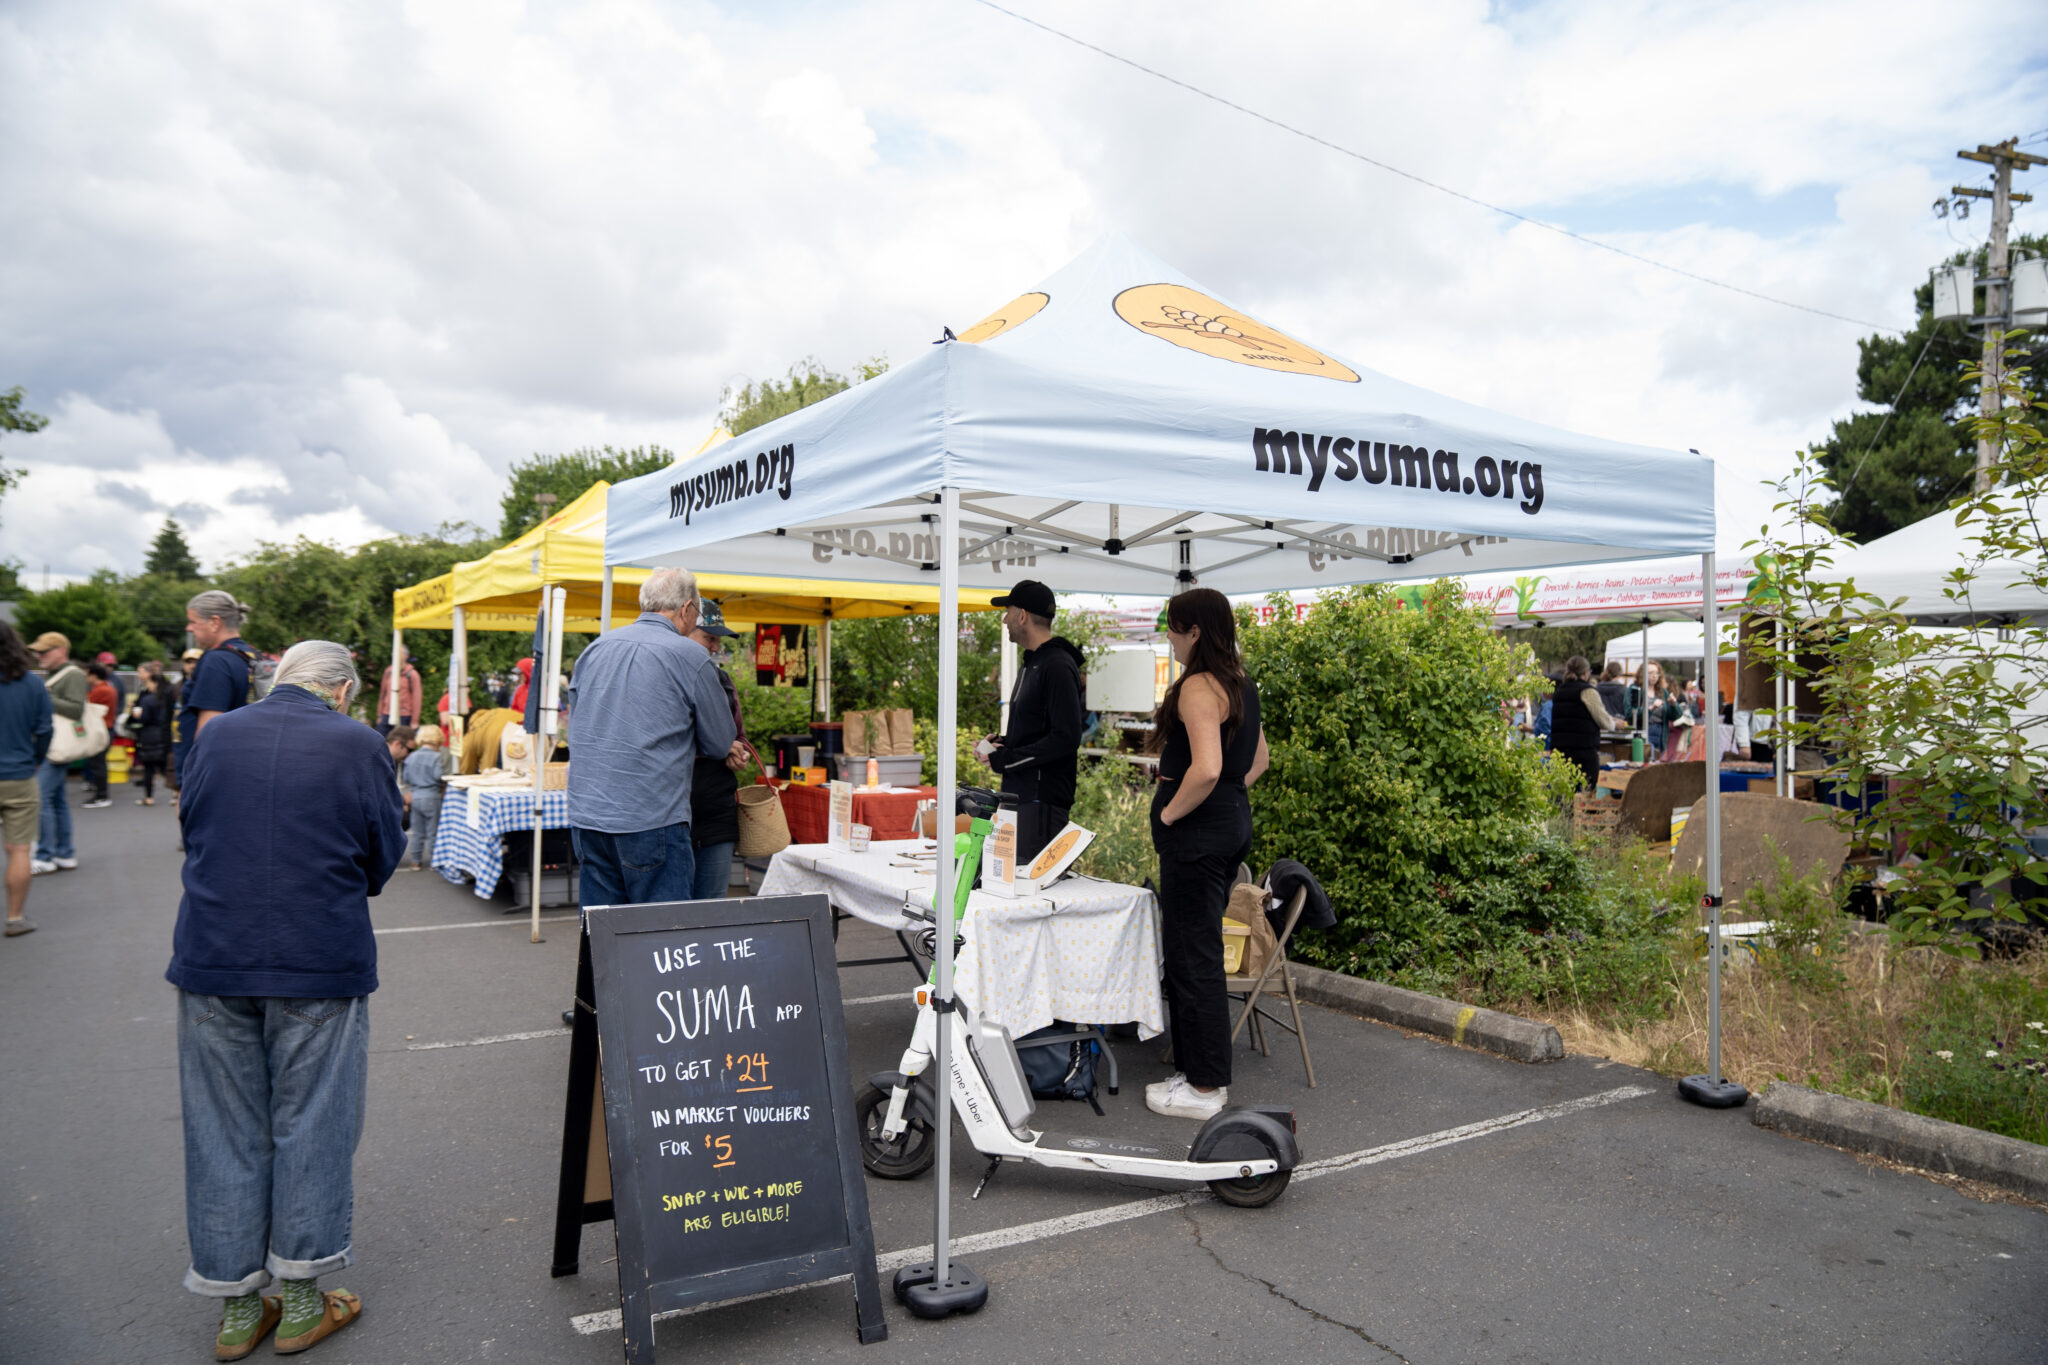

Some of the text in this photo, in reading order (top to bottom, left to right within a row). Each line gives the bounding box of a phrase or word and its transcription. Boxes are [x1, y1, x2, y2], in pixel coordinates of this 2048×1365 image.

[1241, 353, 1295, 363] suma
[669, 442, 794, 526] mysuma.org
[1253, 427, 1544, 515] mysuma.org
[1544, 581, 1570, 592] Broccoli
[1576, 580, 1600, 589] Berries
[1605, 578, 1625, 588] Beans
[1630, 576, 1662, 586] Potatoes
[1667, 571, 1695, 587] Squash
[1575, 594, 1613, 605] Cauliflower
[1616, 593, 1646, 604] Cabbage
[1651, 590, 1692, 600] Romanesco
[653, 938, 756, 974] USE THE
[656, 984, 802, 1043] SUMA APP
[638, 1052, 770, 1083] TO GET $24
[950, 1063, 966, 1089] Lime
[966, 1097, 984, 1125] Uber
[651, 1105, 811, 1128] IN MARKET VOUCHERS
[659, 1134, 733, 1161] FOR $5
[1108, 1143, 1160, 1153] Lime
[662, 1181, 803, 1212] SNAP + WIC + MORE
[684, 1203, 789, 1234] ARE ELIGIBLE!
